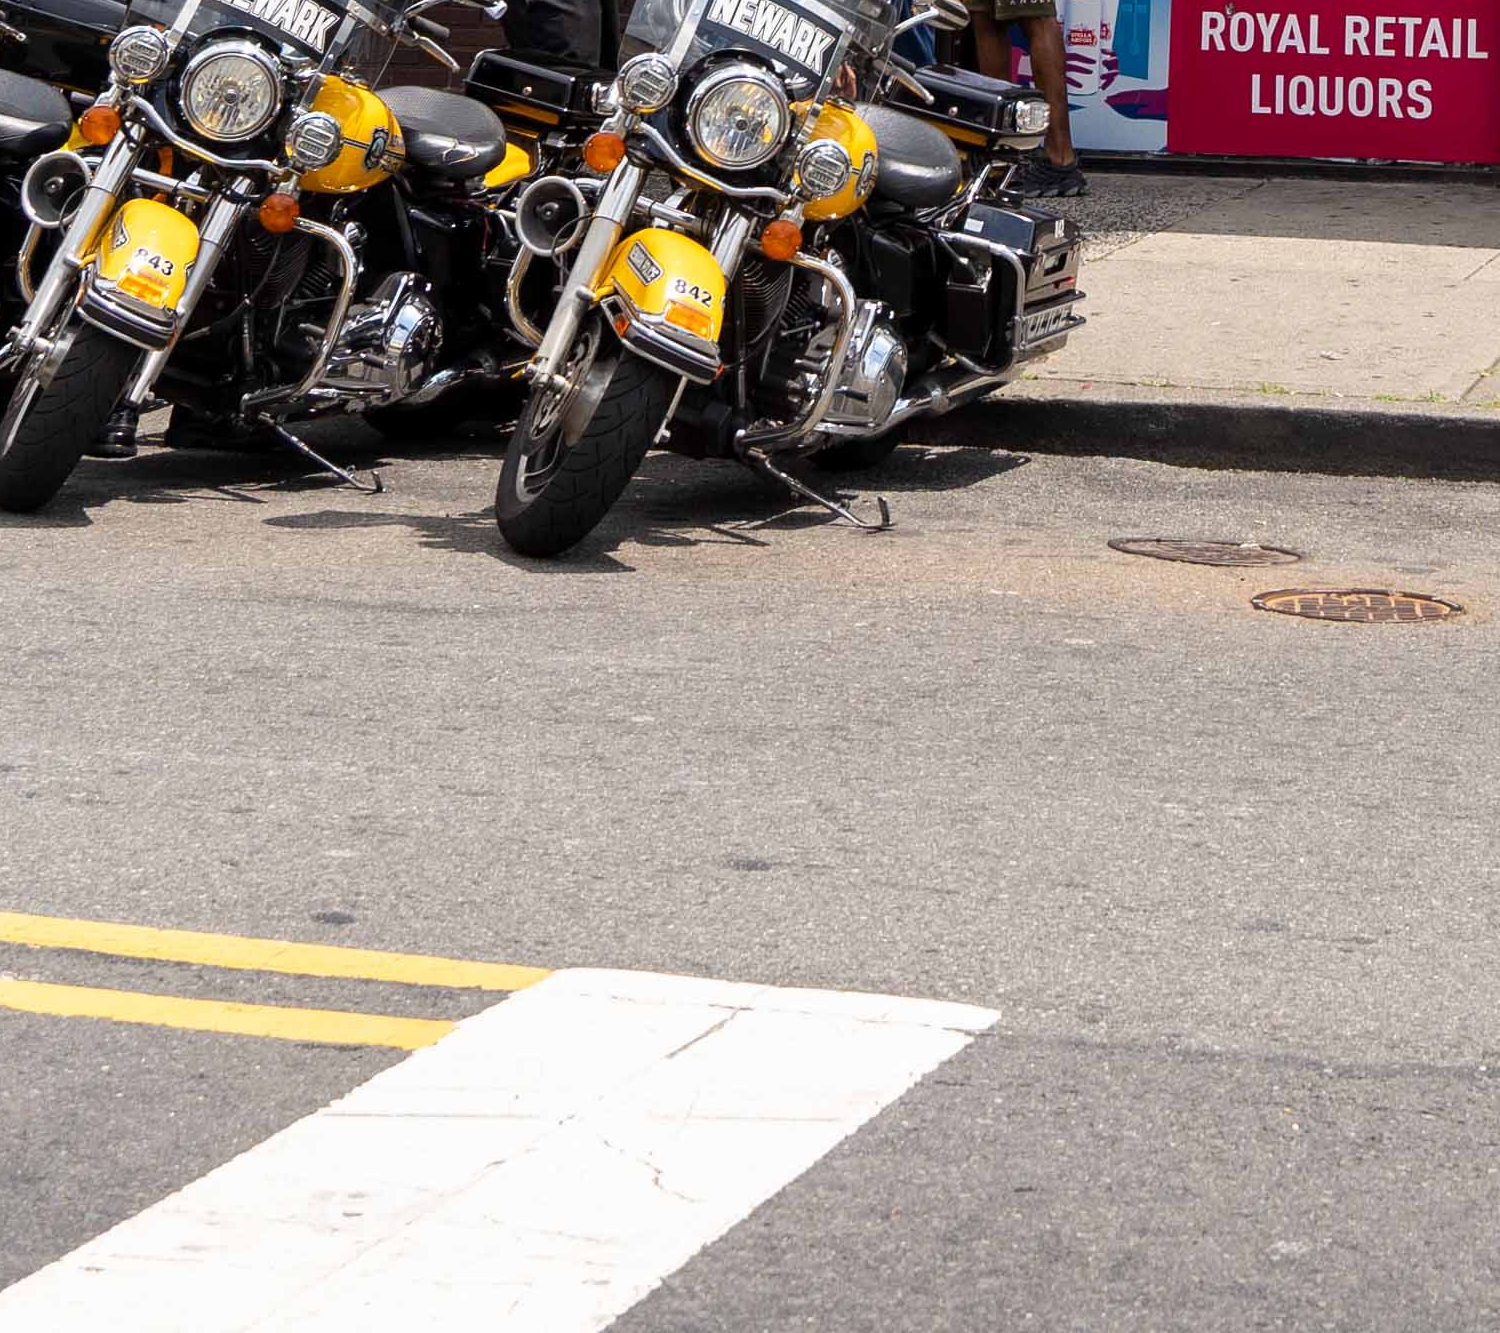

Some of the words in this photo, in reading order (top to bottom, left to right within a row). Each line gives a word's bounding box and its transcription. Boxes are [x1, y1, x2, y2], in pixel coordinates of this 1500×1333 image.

[1200, 11, 1330, 55] ROYAL
[1344, 15, 1489, 59] RETAIL
[1251, 73, 1433, 120] LIQUORS
[674, 279, 713, 308] 842
